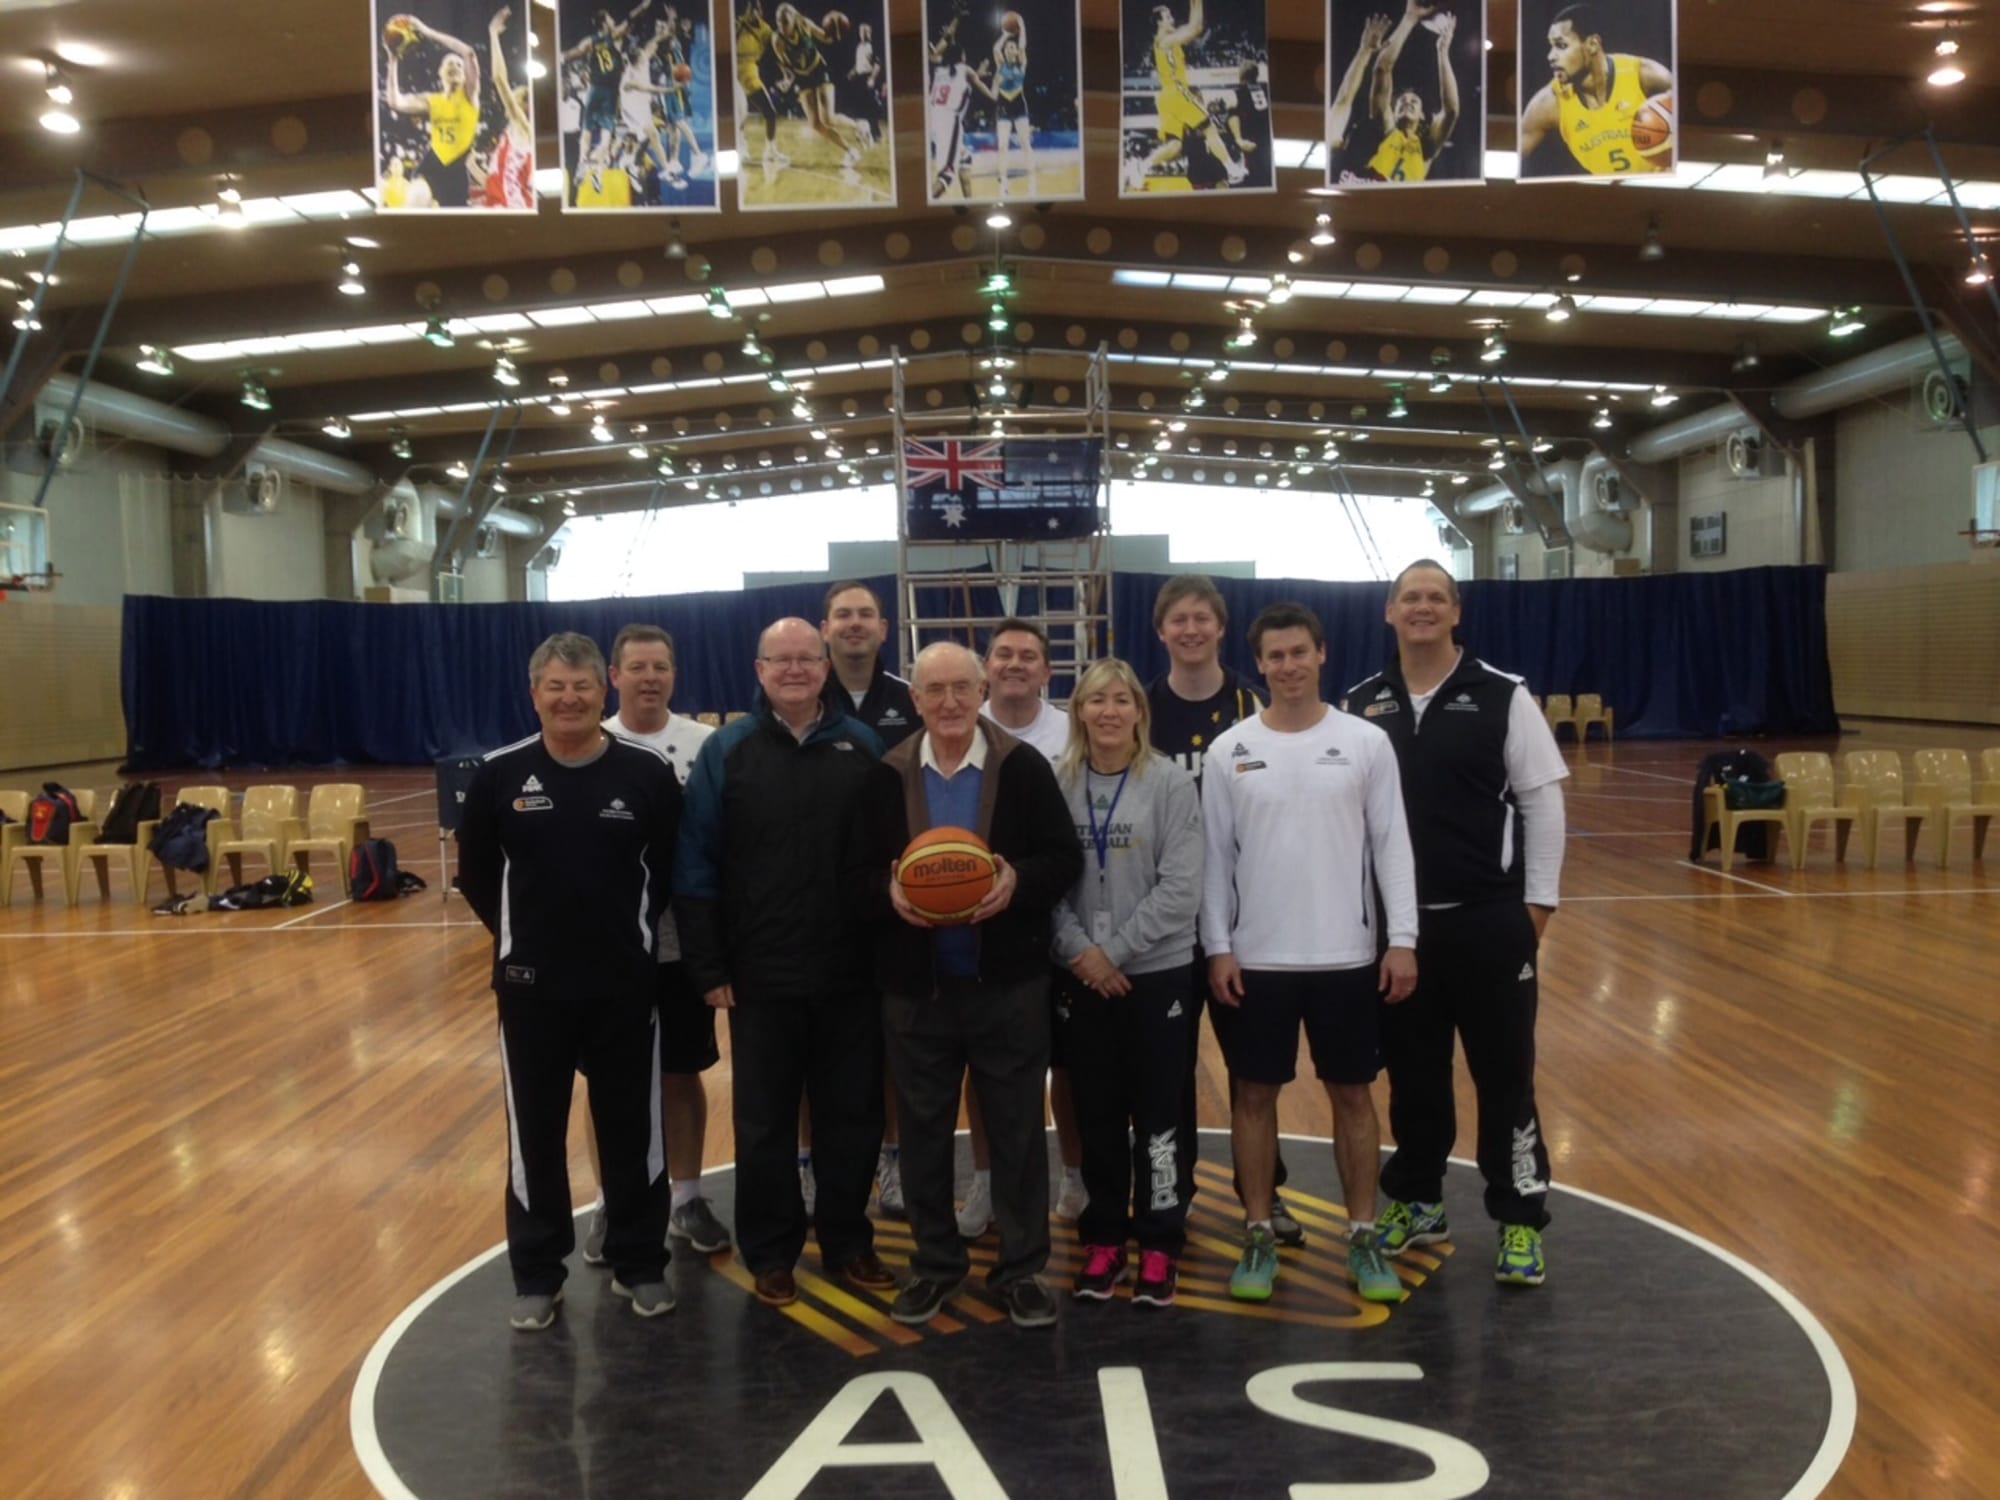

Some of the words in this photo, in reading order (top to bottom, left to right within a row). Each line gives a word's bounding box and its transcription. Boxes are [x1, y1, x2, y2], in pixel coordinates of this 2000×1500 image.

[1608, 148, 1632, 172] 5
[912, 856, 977, 878] molten
[1148, 1126, 1179, 1211] PEAK
[1512, 1117, 1549, 1197] PEAK
[740, 1361, 1490, 1500] AIS
